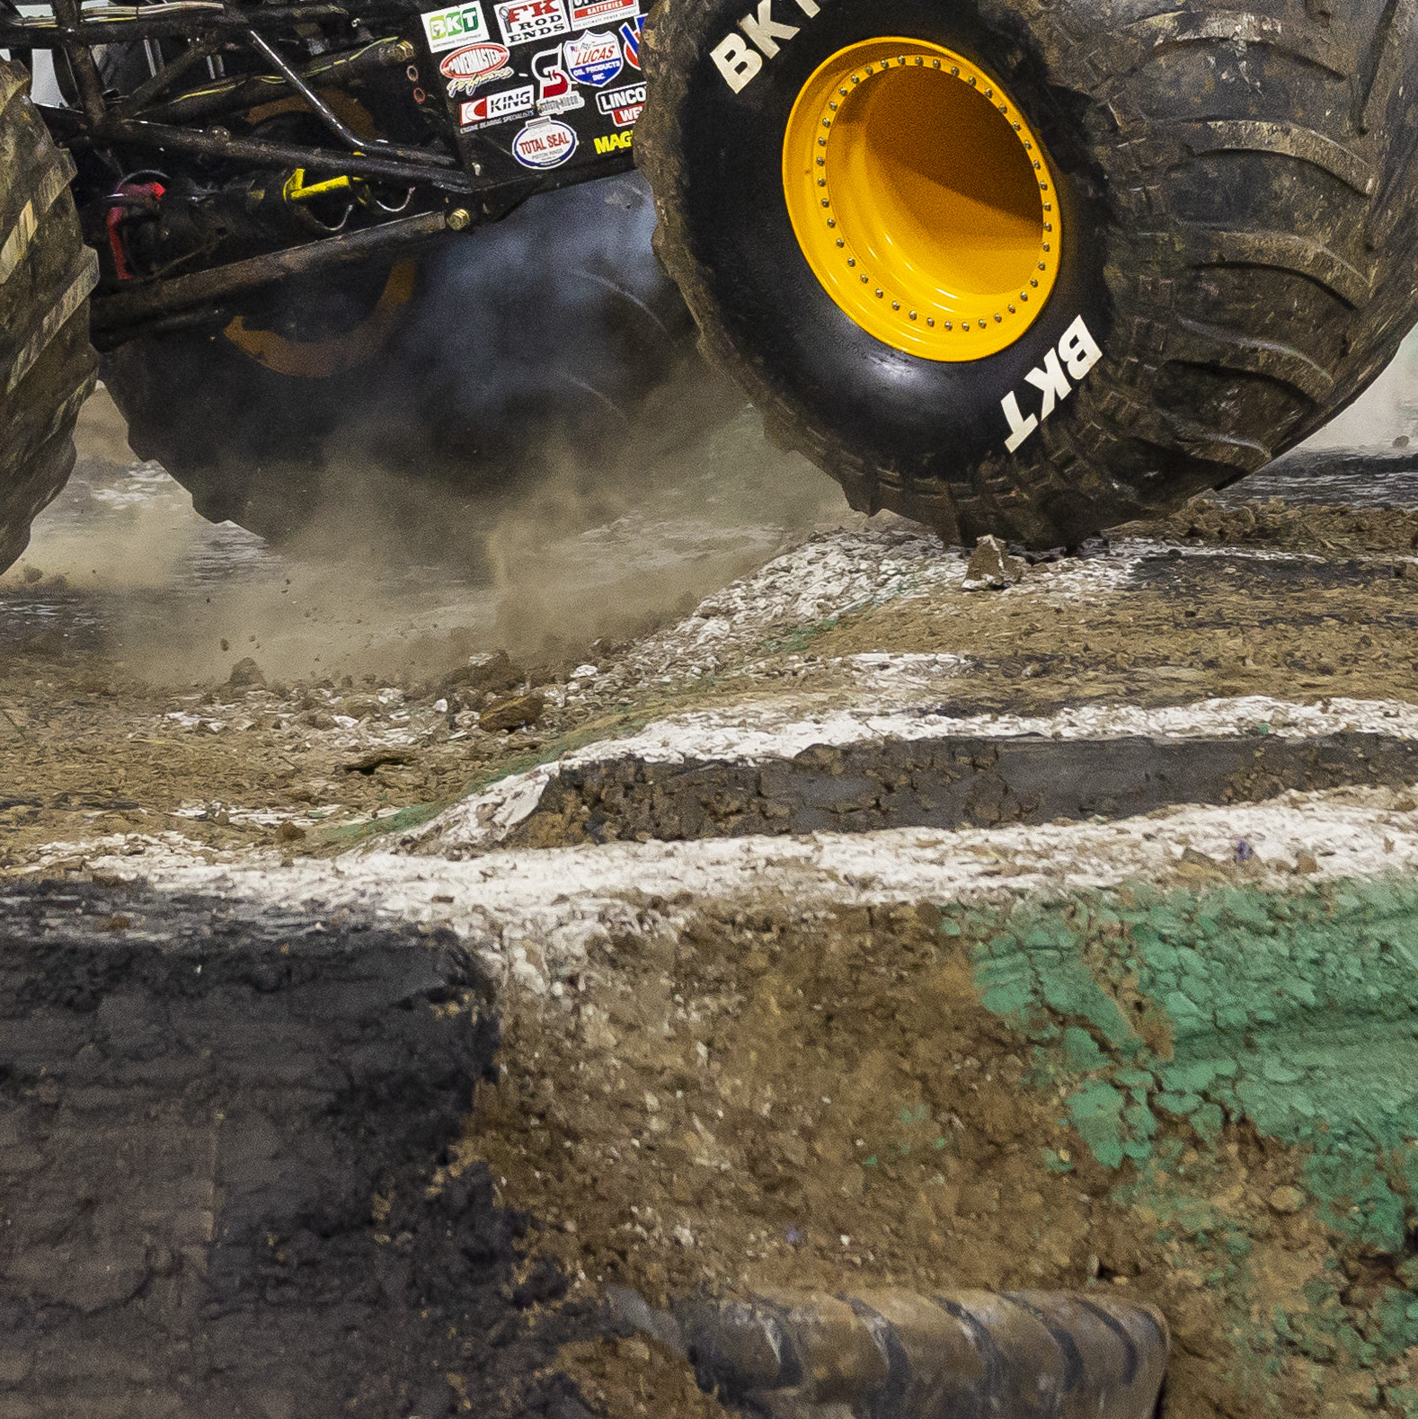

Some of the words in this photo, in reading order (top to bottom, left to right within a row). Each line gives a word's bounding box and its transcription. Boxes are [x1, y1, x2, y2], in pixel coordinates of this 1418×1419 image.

[586, 0, 623, 16] BATTERIES
[429, 8, 479, 41] BKT
[508, 23, 566, 43] ENDS
[518, 14, 563, 31] ROD
[574, 45, 616, 66] LUCAS
[490, 90, 531, 114] KING
[601, 86, 647, 111] LINCO
[519, 139, 546, 156] TOTAL
[546, 131, 570, 148] SEAL
[593, 129, 633, 154] MAG
[1000, 314, 1103, 454] BKT
